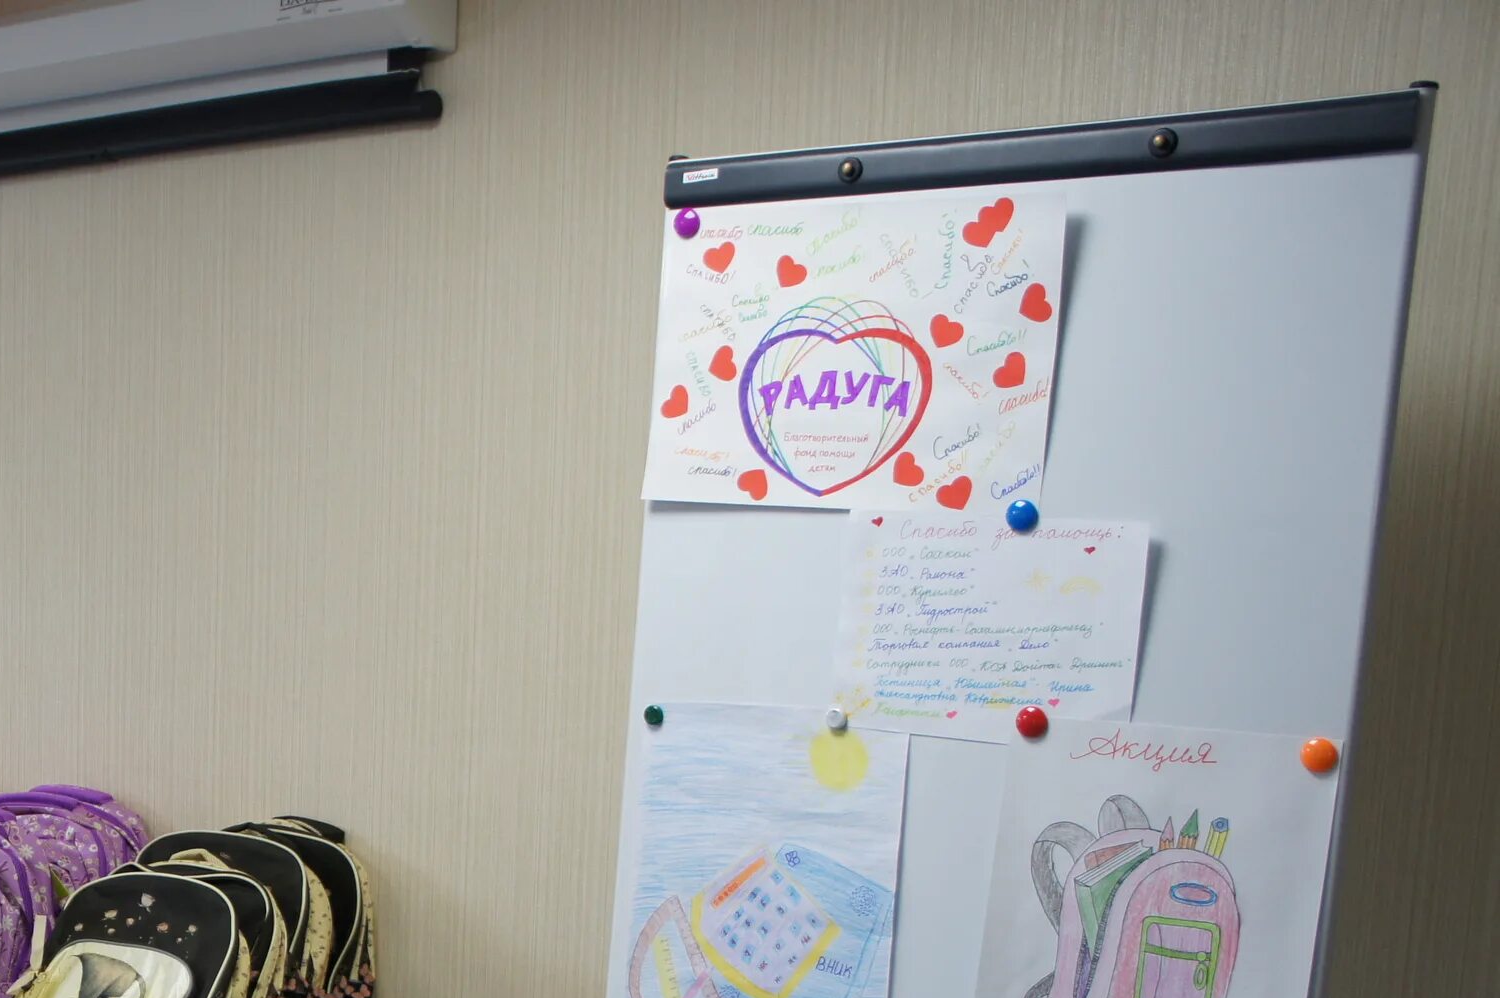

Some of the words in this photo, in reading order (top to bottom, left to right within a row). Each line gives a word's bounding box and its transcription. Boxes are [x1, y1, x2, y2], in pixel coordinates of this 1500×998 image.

[758, 369, 912, 418] РАДУГА
[783, 431, 869, 445] Благотворительный
[794, 447, 817, 460] фонд
[819, 449, 856, 458] помощи
[899, 519, 978, 540] Спасибо
[1070, 729, 1217, 773] Акция
[815, 956, 853, 979] ВНИК
